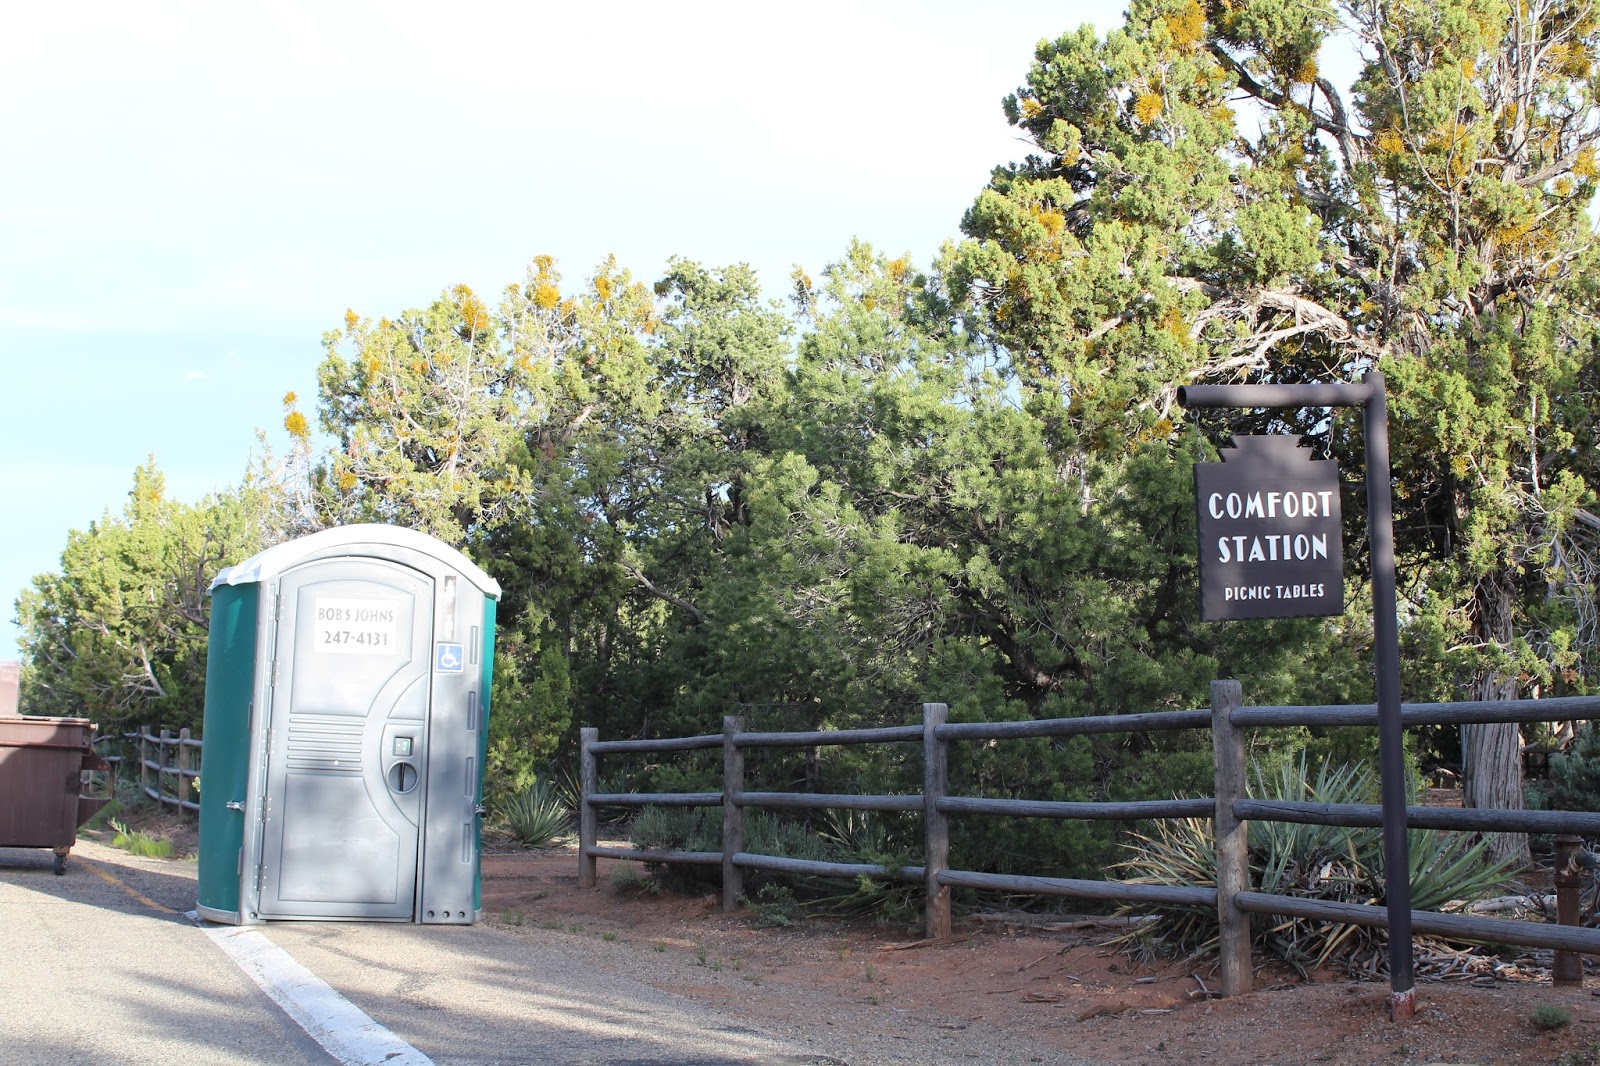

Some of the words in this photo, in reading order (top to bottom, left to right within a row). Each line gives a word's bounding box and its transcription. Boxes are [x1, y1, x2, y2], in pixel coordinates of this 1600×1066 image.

[1208, 491, 1333, 520] COMFORT
[1218, 533, 1328, 563] STATION
[1224, 585, 1271, 601] PICNIC
[1275, 583, 1325, 599] TABLES
[318, 607, 351, 621] BOB'S
[355, 608, 393, 622] JOHNS
[324, 630, 388, 646] 247-4131
